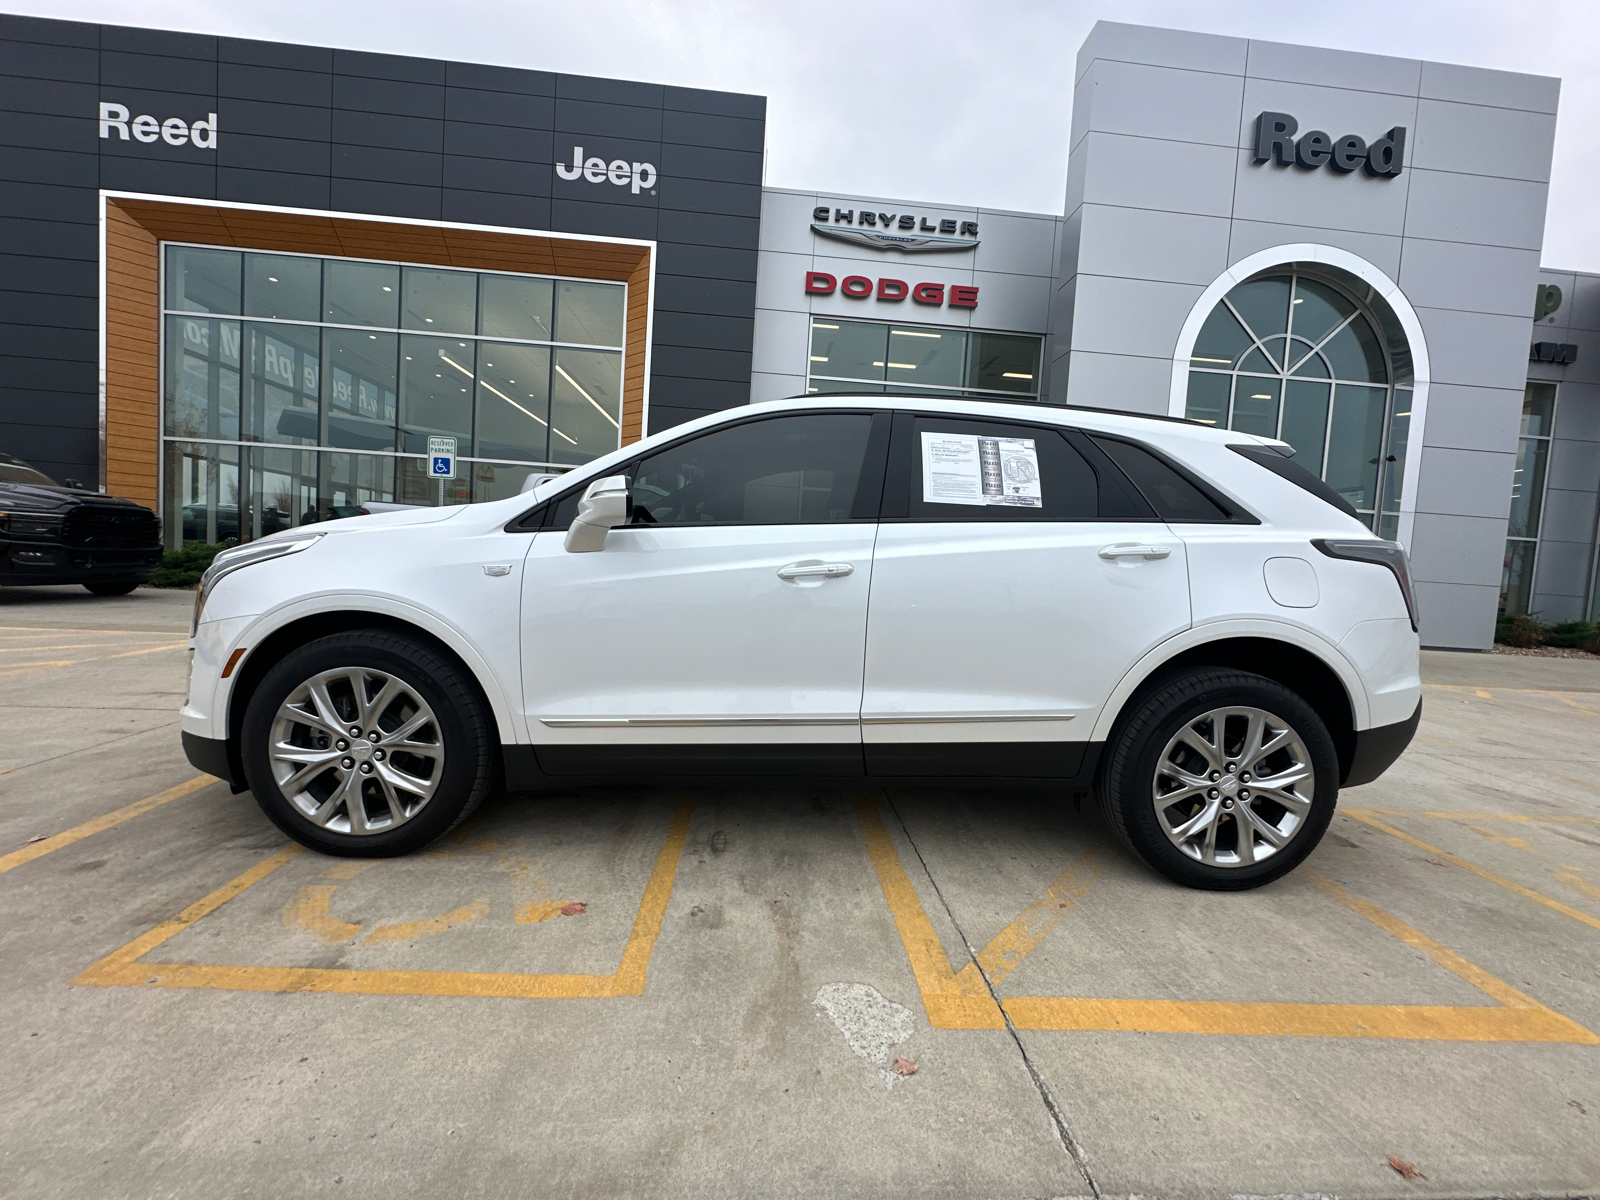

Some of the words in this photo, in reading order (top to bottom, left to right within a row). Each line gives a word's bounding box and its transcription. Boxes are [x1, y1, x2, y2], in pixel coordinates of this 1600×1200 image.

[99, 101, 217, 149] Reed
[1252, 111, 1407, 179] Reed
[556, 146, 657, 196] Jeep
[813, 206, 979, 235] CHRYSLER
[805, 271, 979, 308] DODGE
